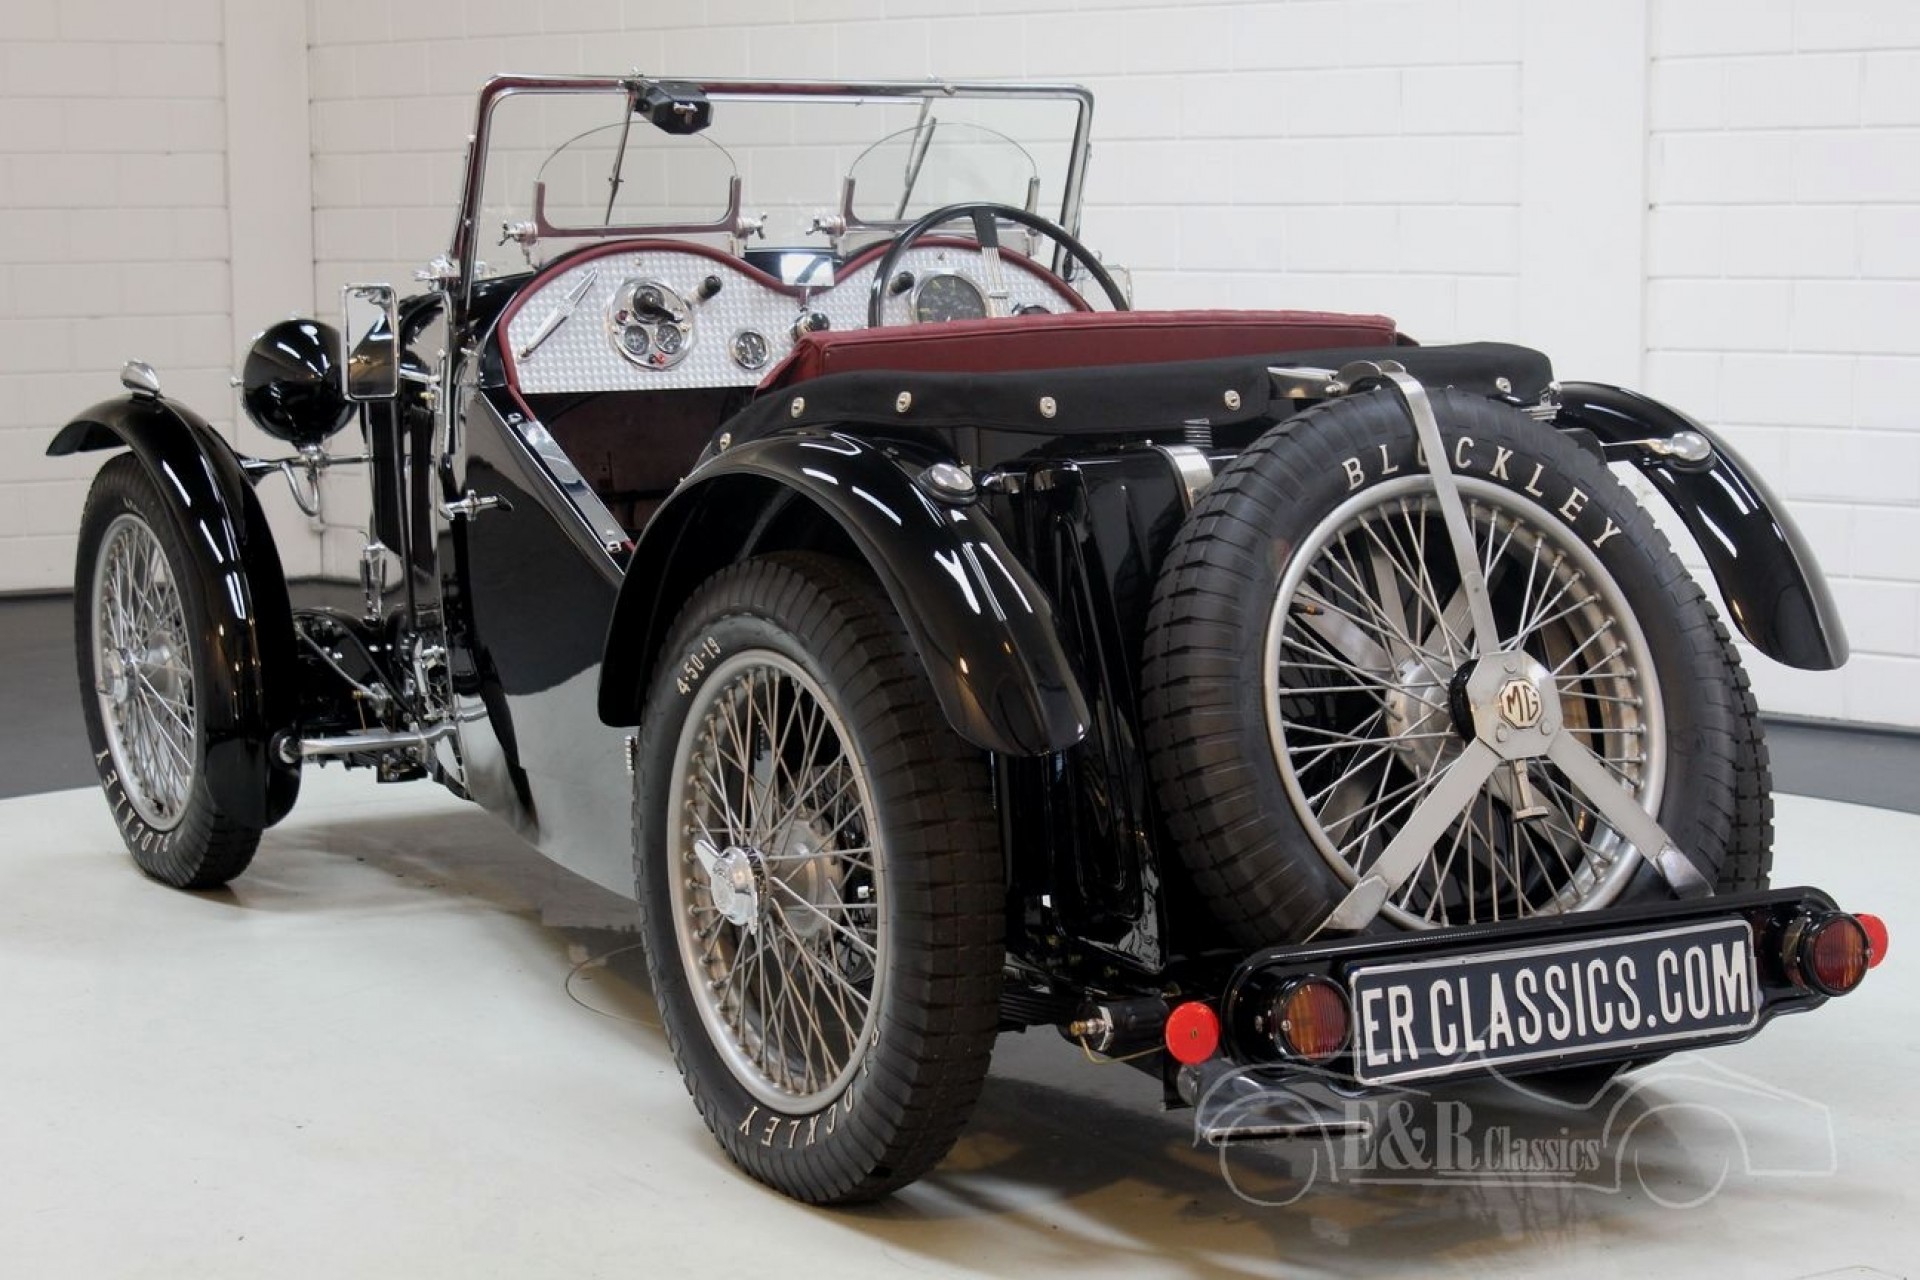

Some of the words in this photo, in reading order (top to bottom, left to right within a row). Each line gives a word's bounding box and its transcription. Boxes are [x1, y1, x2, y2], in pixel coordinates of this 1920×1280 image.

[1506, 685, 1539, 722] MG
[1361, 984, 1419, 1067] ER
[1429, 940, 1750, 1057] CLASSICS.COM
